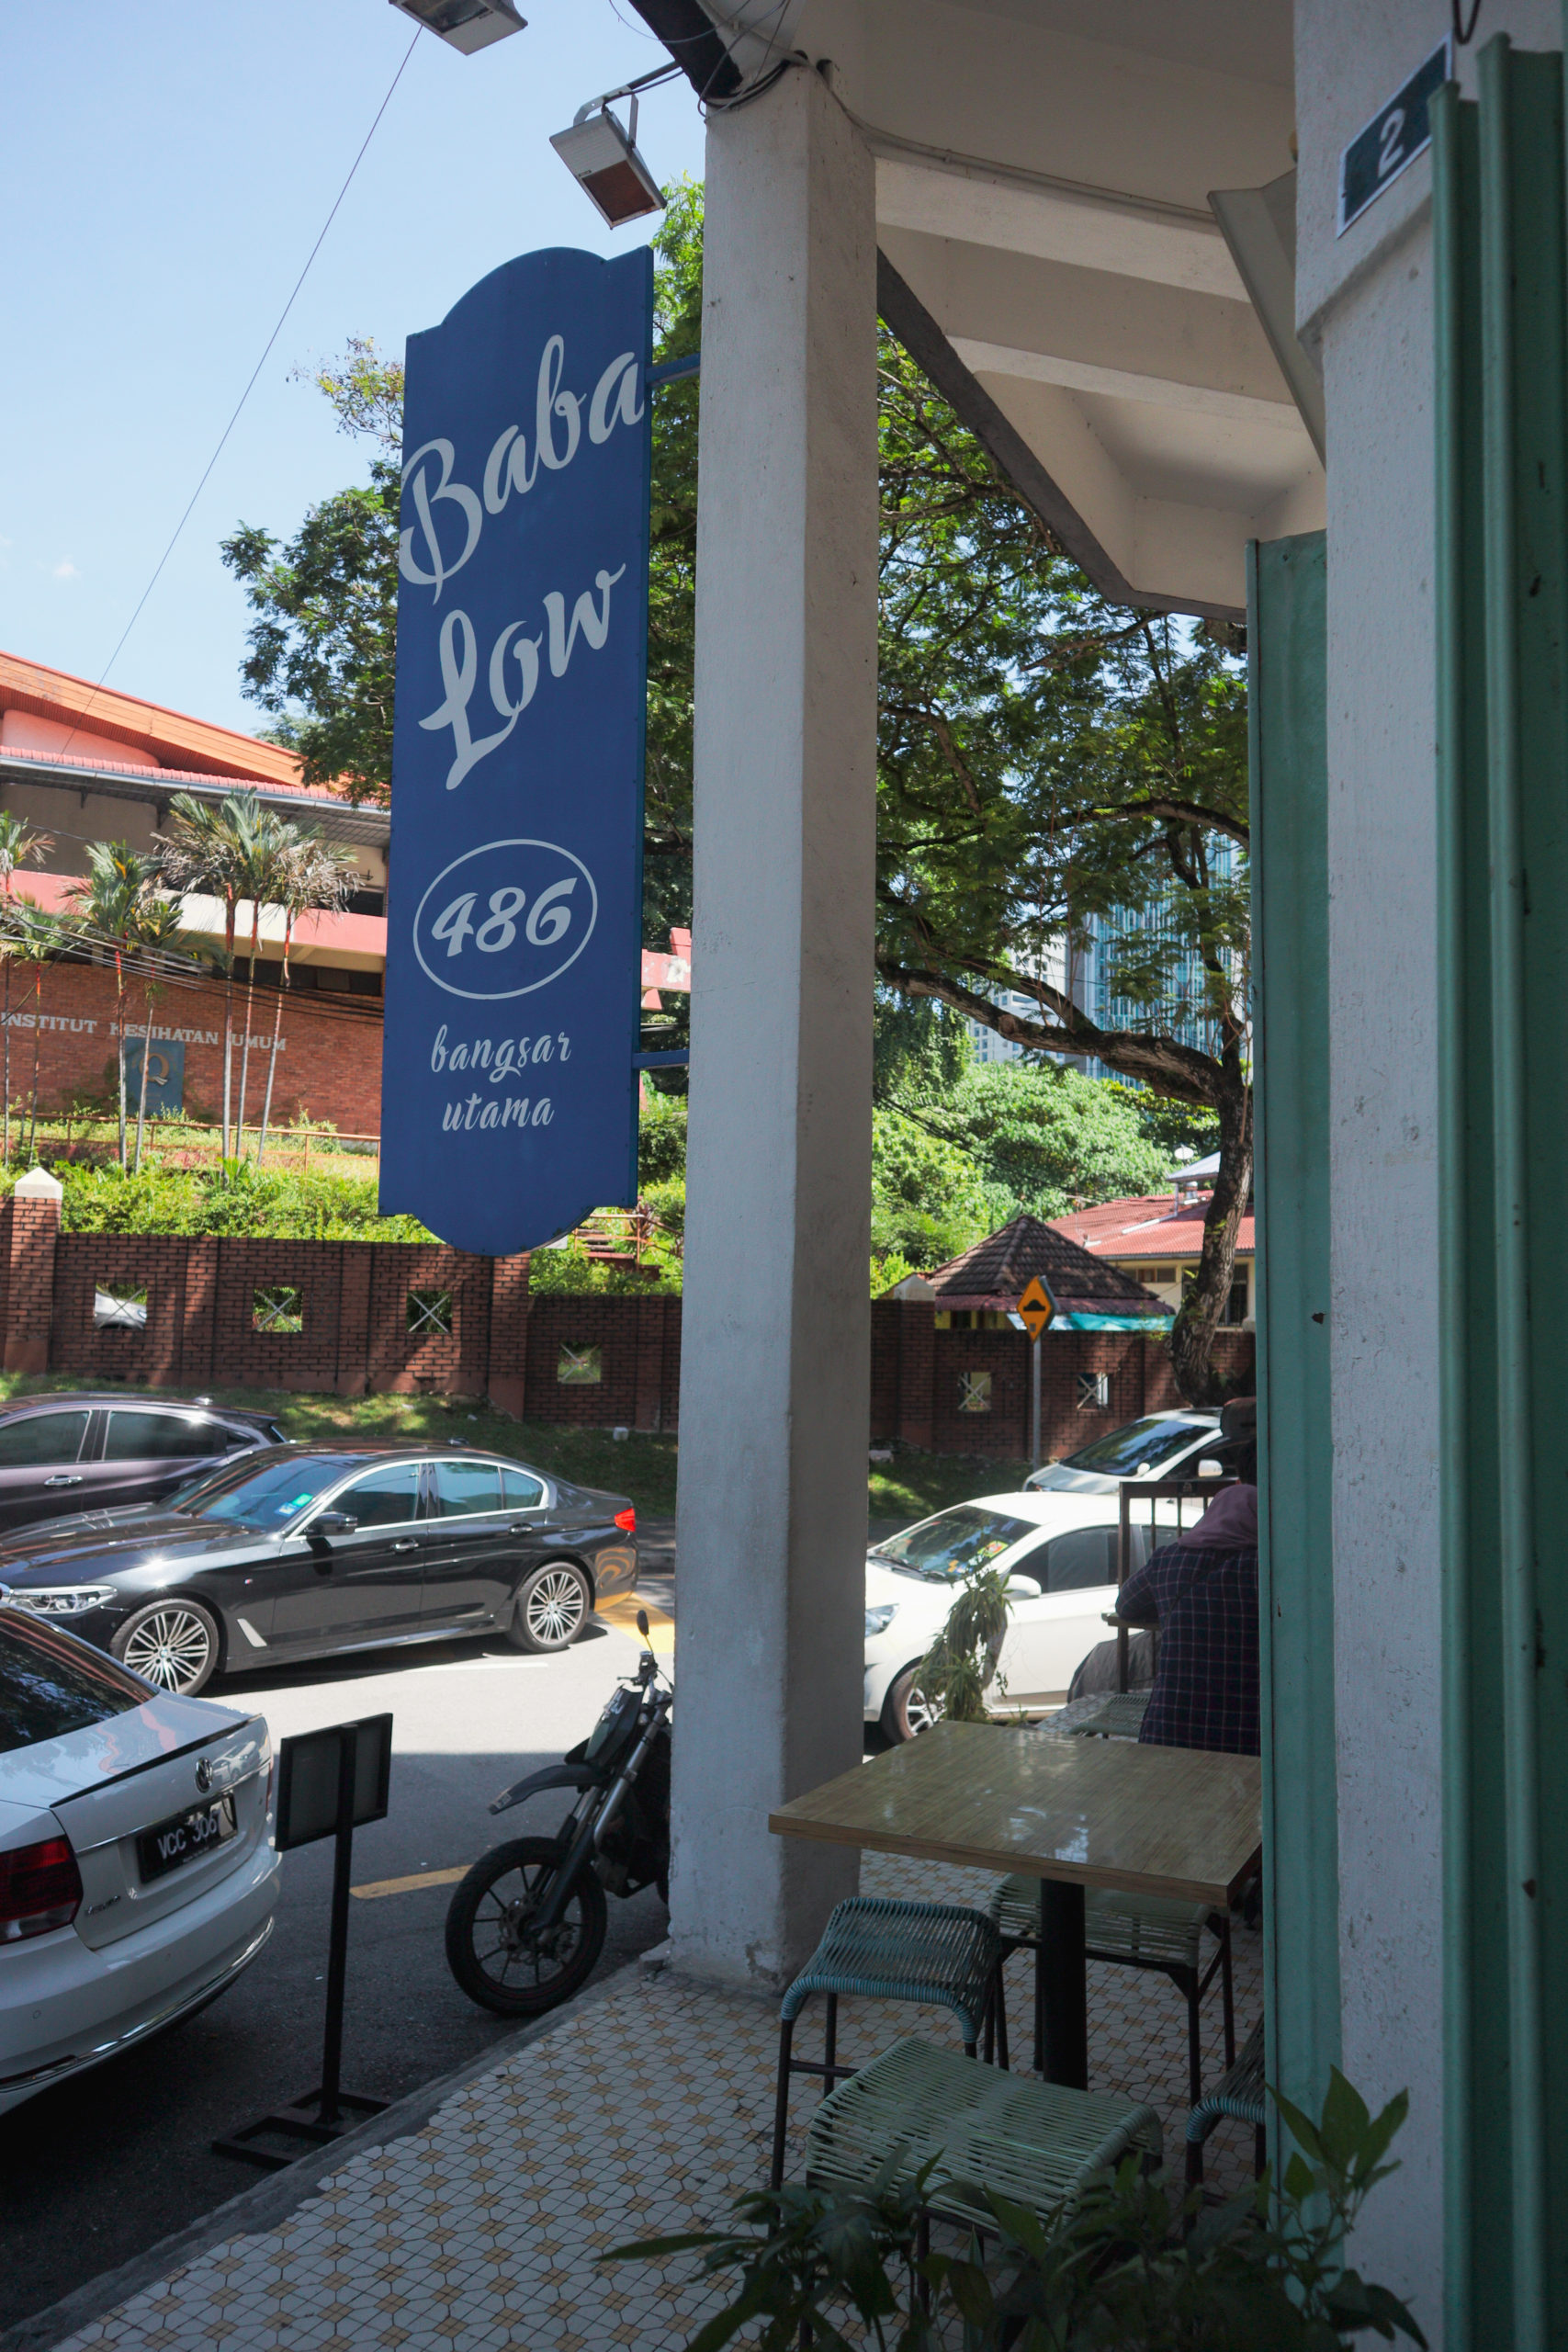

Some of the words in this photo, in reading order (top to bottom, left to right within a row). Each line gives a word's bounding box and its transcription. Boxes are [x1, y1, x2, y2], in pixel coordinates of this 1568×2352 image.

[1378, 108, 1404, 178] 2
[399, 334, 645, 606] Baba
[418, 562, 626, 790] Low
[431, 877, 578, 957] 486
[0, 1012, 97, 1034] INSTITUT
[109, 1022, 219, 1045] KESIHATAN
[230, 1033, 287, 1051] UMUM
[430, 1023, 571, 1083] bangsar
[441, 1092, 555, 1132] utama
[157, 1828, 186, 1860] VCC
